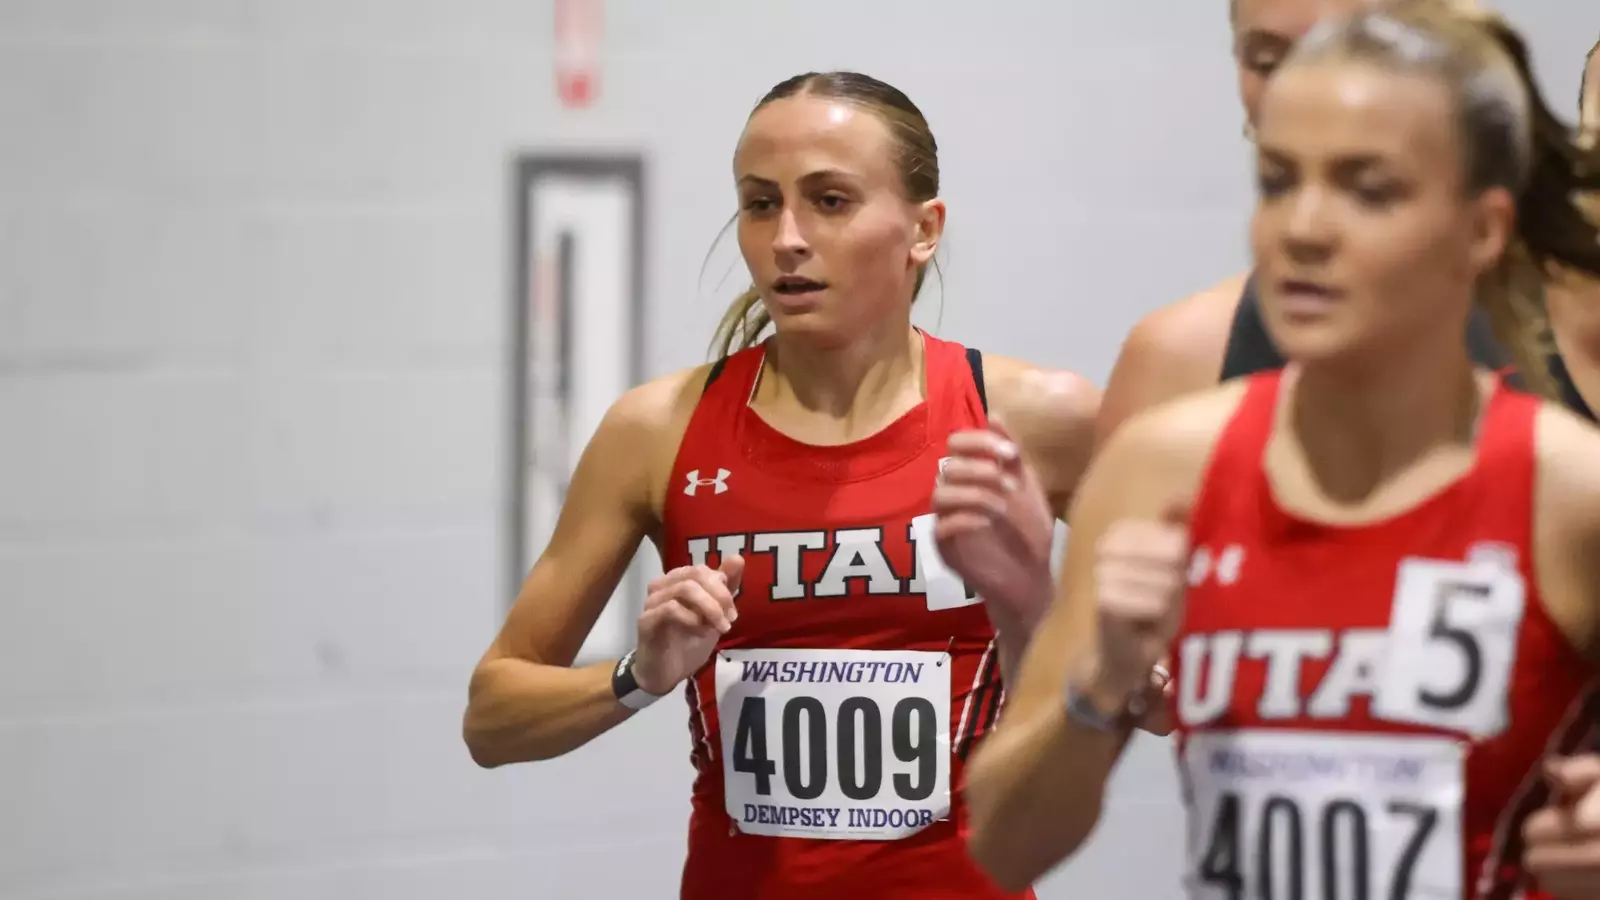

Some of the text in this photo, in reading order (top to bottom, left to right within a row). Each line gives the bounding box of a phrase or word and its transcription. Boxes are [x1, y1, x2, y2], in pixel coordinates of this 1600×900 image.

[687, 524, 926, 601] UTA
[741, 660, 924, 684] WASHINGTON
[1177, 628, 1393, 726] UTA
[1417, 581, 1493, 710] 5
[733, 696, 937, 800] 4009
[743, 803, 933, 828] DEMPSEY INDOOR
[1201, 793, 1438, 900] 4007
